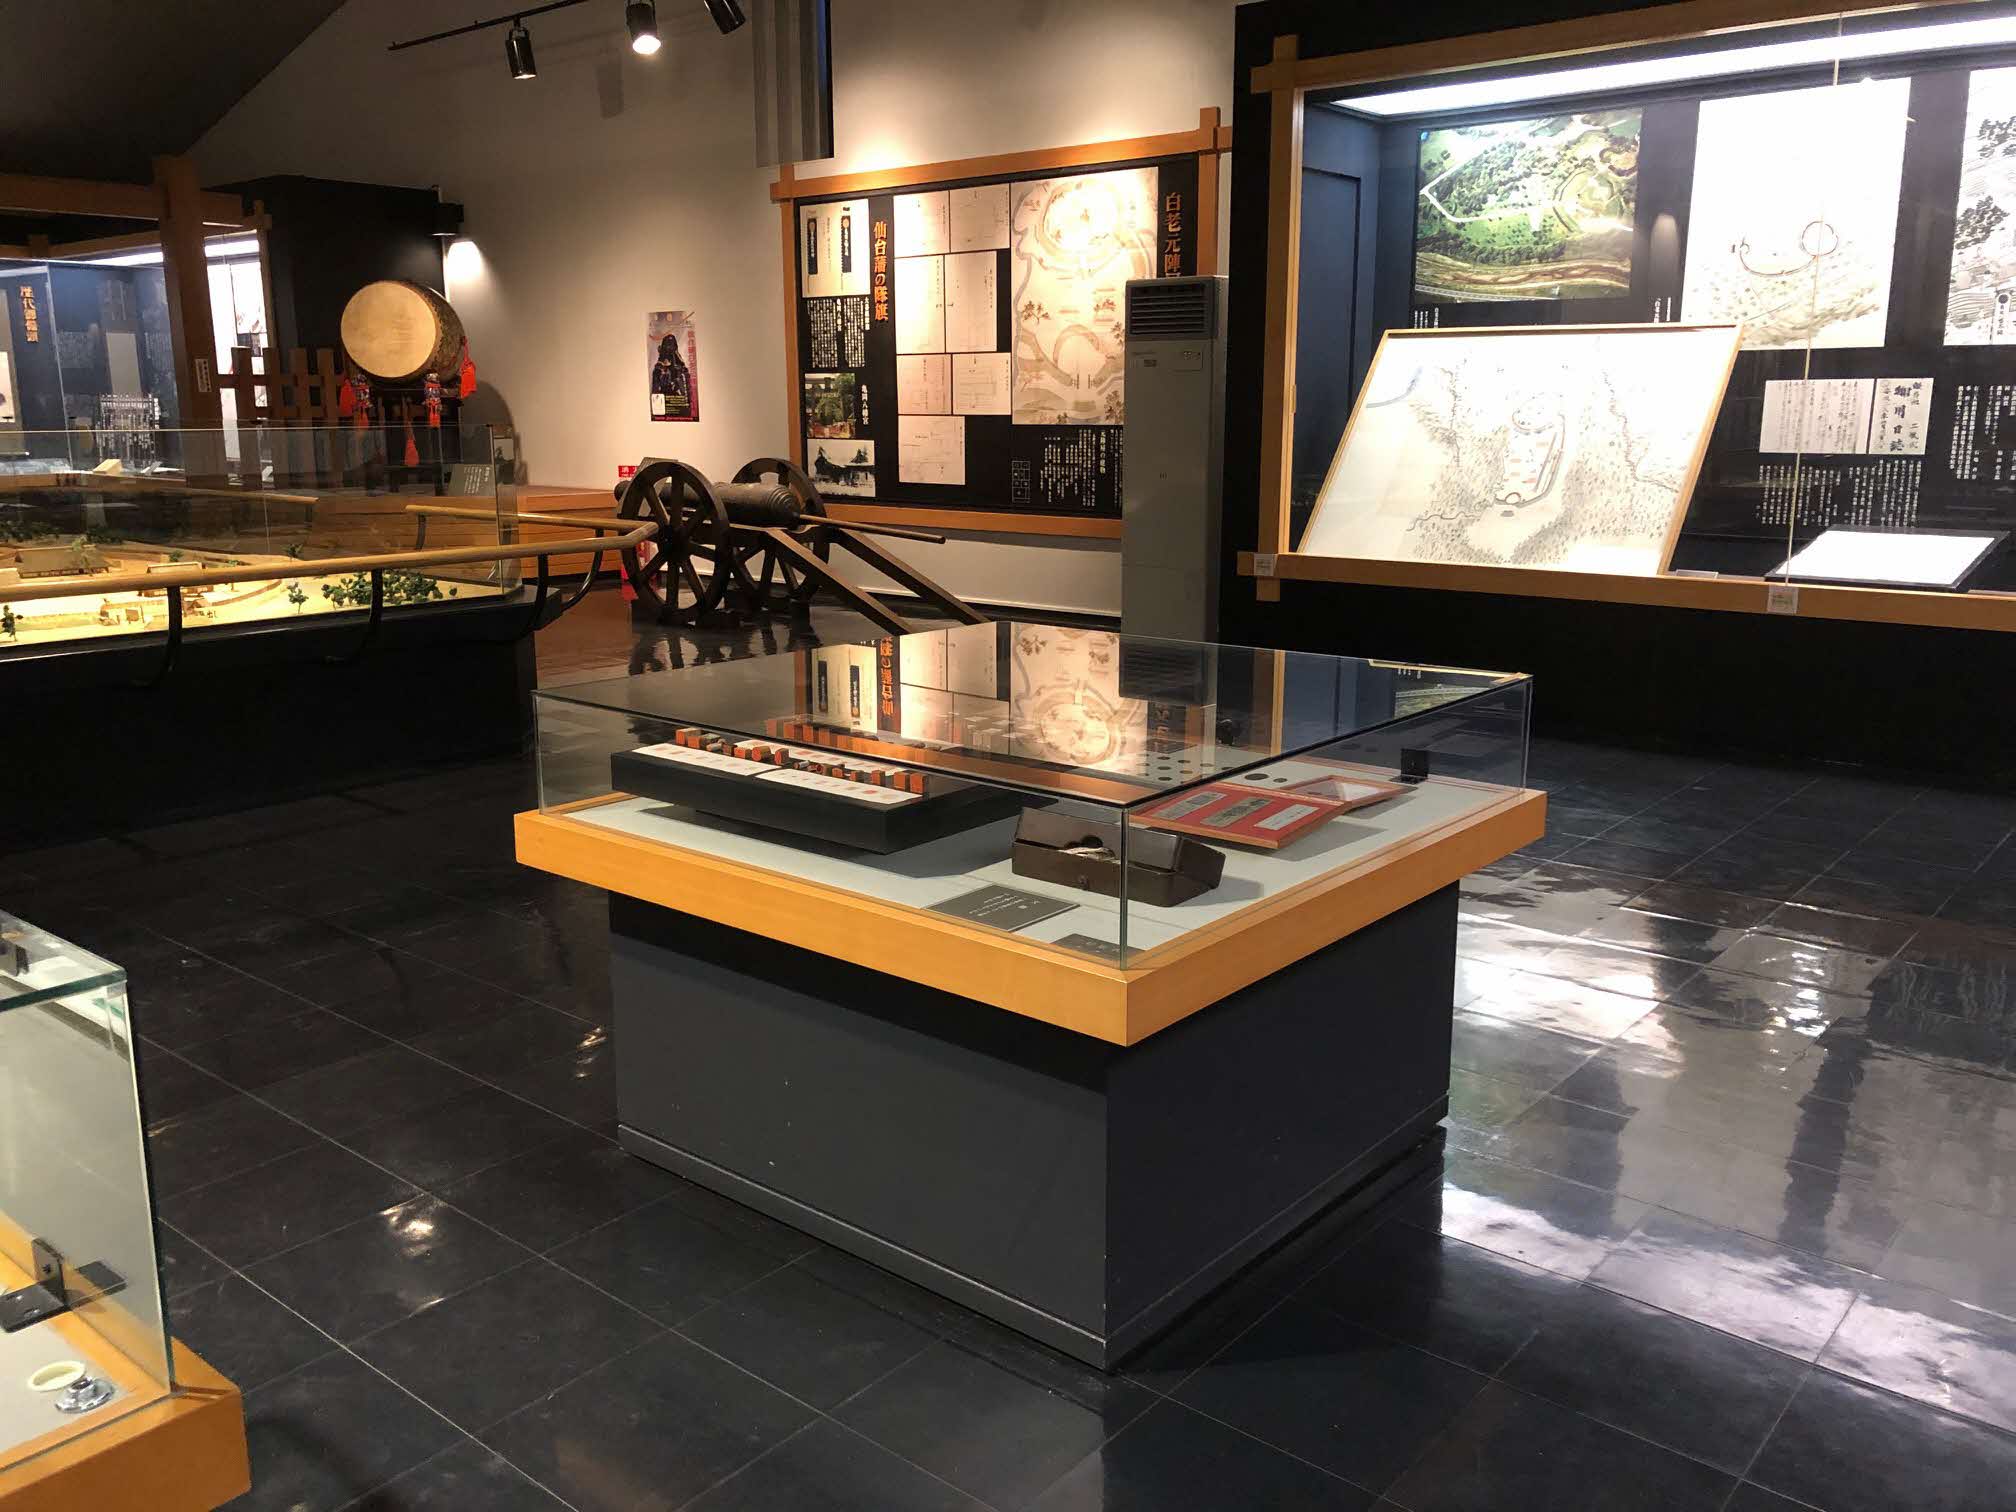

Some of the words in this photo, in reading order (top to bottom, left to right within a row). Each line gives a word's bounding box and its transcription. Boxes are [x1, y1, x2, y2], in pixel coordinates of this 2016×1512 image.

[873, 221, 889, 321] 仙台藩の隊旗
